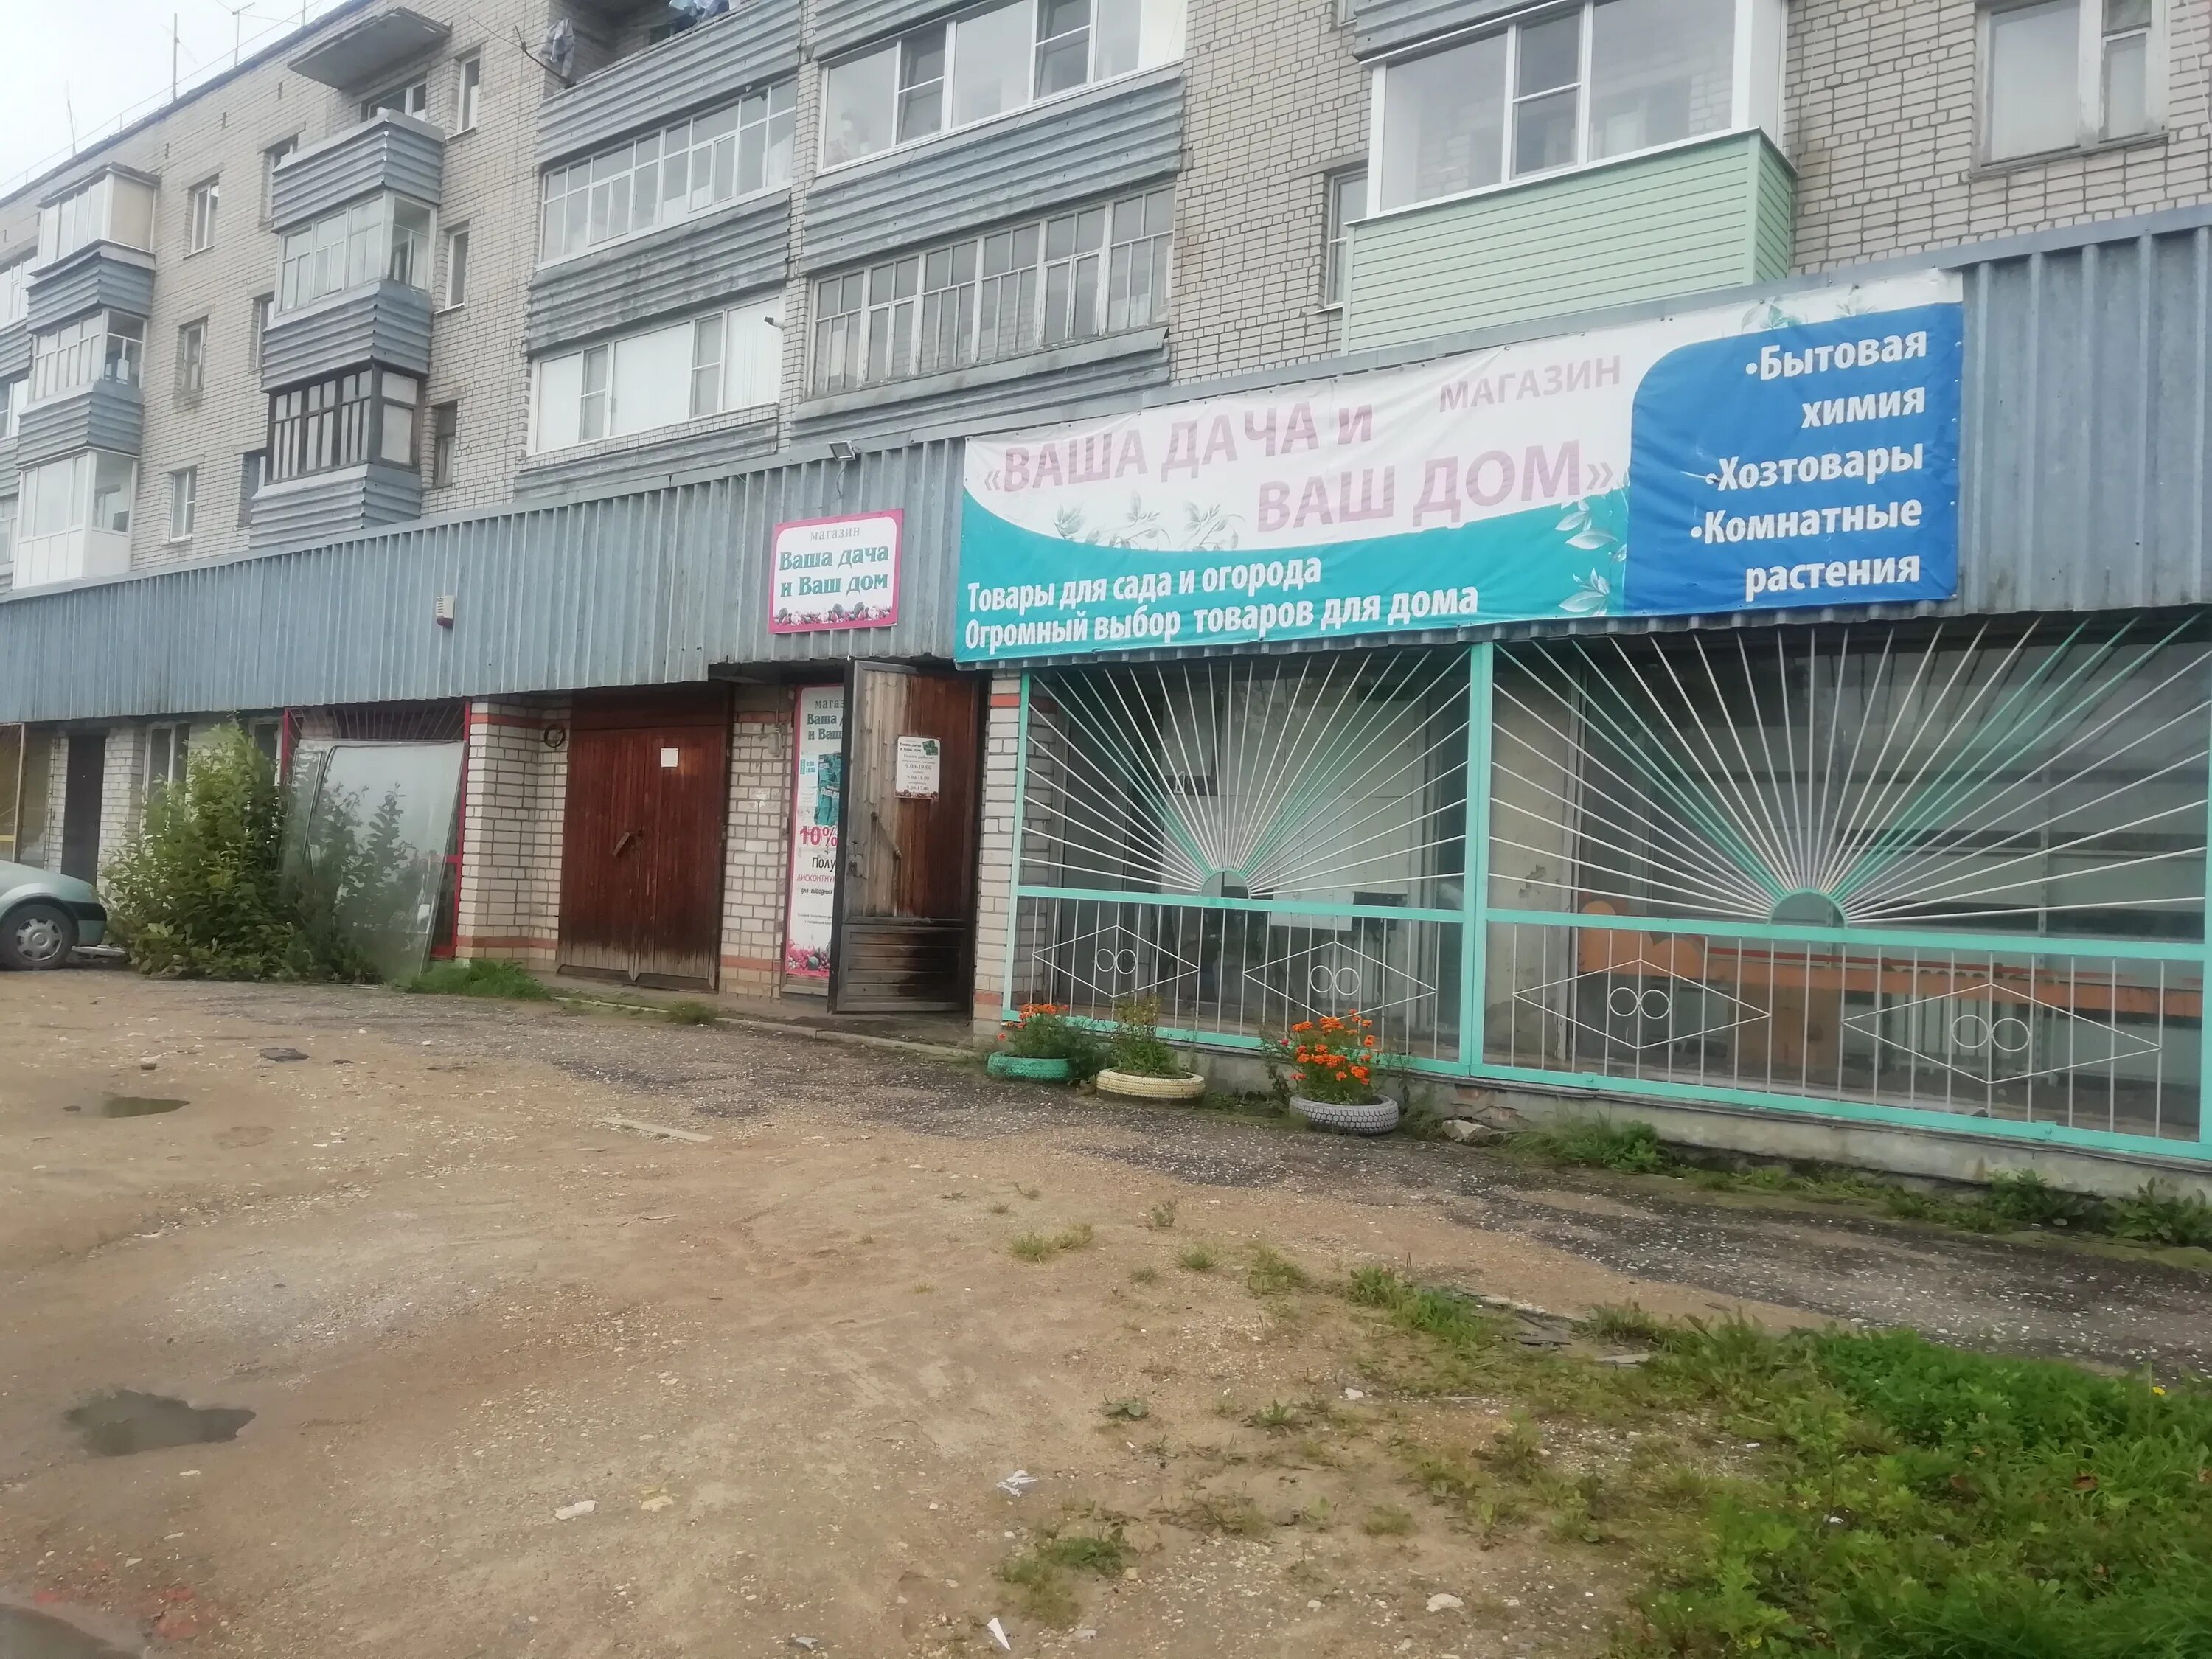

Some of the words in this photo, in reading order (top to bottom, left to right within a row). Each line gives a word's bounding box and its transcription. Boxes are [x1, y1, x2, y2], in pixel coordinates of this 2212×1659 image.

[1760, 330, 1927, 380] Бытовая
[1439, 355, 1621, 412] МАГАЗИН
[1801, 386, 1926, 428] химия
[984, 429, 1148, 493] «ВАША
[1161, 402, 1320, 483] ДАЧА
[1717, 443, 1924, 491] Хозтовары
[1257, 465, 1395, 532] ВАШ
[1412, 439, 1614, 527] ДОМ»
[810, 526, 860, 541] магазин
[1704, 498, 1923, 544] Комнатные
[779, 551, 832, 571] Ваша
[838, 546, 889, 570] дача
[1745, 555, 1921, 602] растения
[780, 582, 793, 597] и
[799, 576, 841, 596] Ваш
[846, 573, 889, 597] дом
[968, 582, 1054, 616] Товары
[1059, 578, 1107, 611] для
[1113, 571, 1172, 603] сада
[1179, 570, 1195, 594] и
[1202, 557, 1322, 597] огорода
[965, 610, 1088, 655] Огромный
[1093, 605, 1180, 643] выбор
[1193, 599, 1315, 639] товаров
[1320, 594, 1381, 630] для
[1387, 586, 1479, 625] дома
[807, 713, 838, 725] Ваша
[815, 699, 844, 709] магаз
[808, 731, 815, 740] и
[812, 857, 837, 872] Полу
